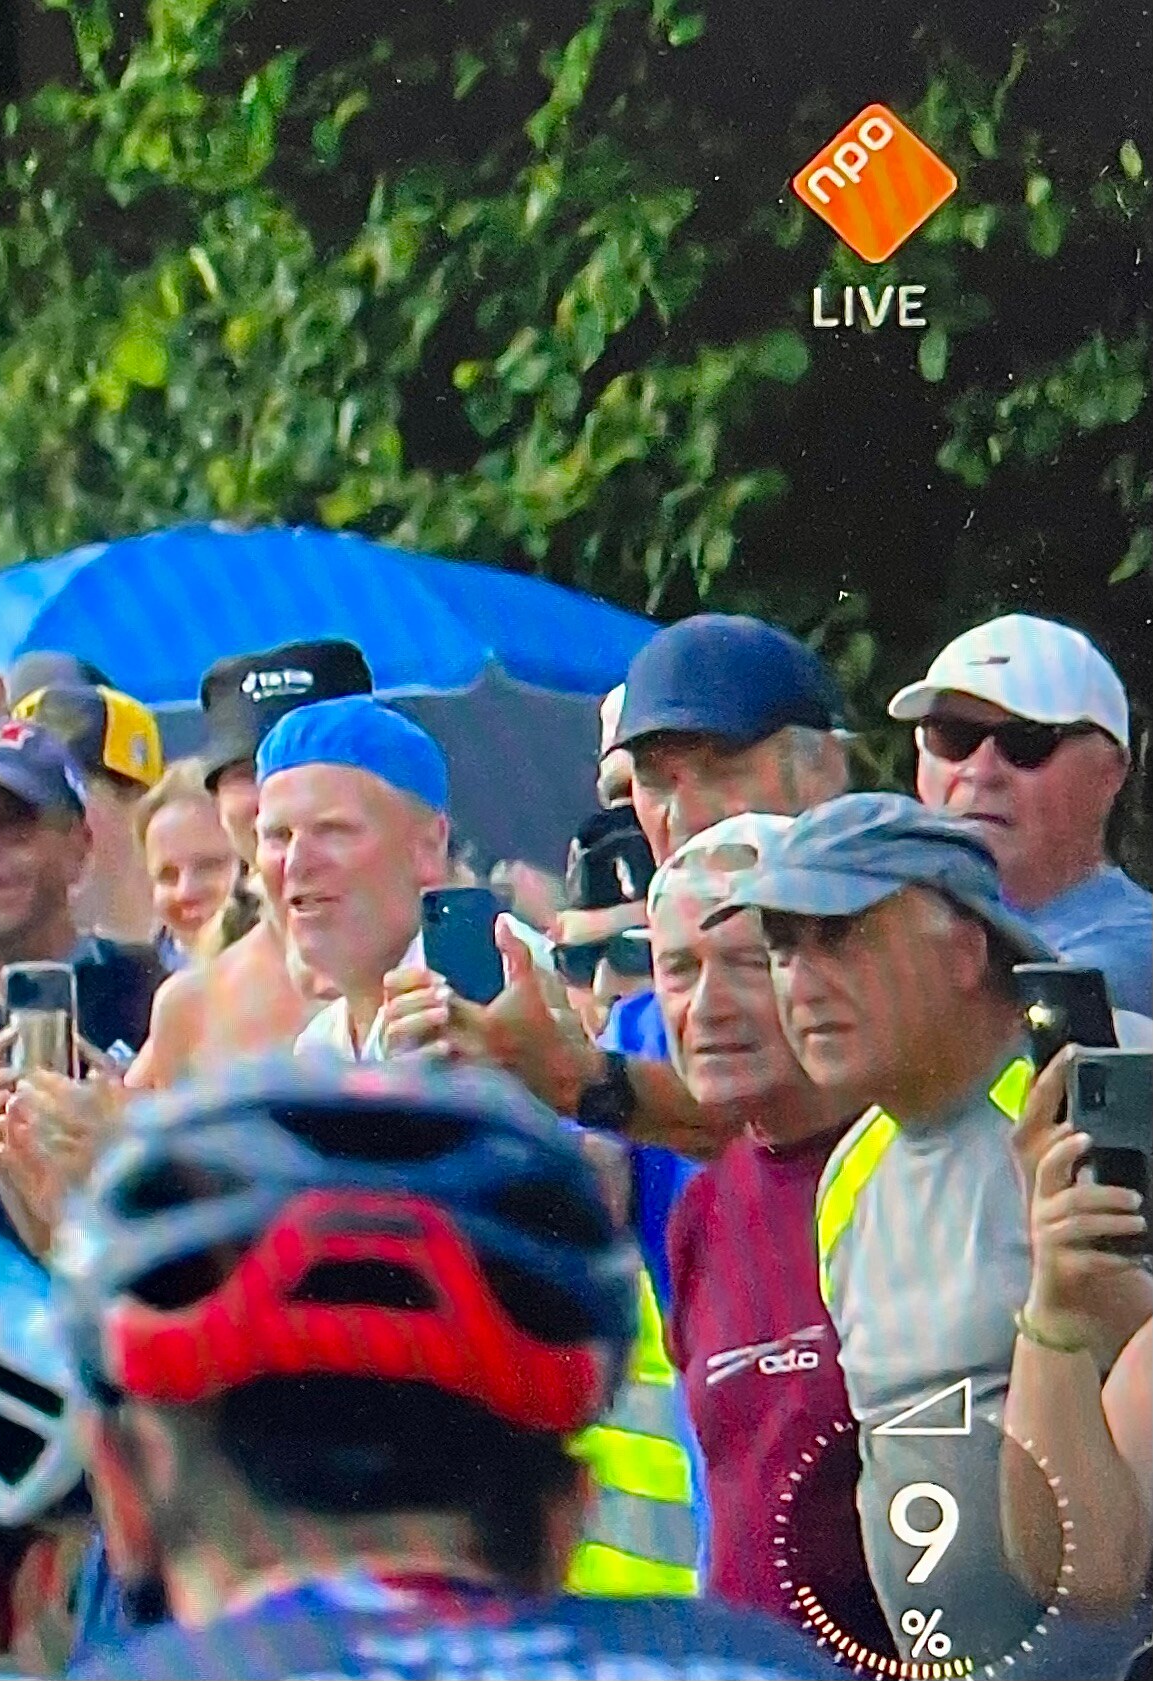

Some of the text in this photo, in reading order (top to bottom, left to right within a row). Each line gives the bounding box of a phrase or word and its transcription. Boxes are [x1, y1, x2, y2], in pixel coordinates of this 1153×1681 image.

[807, 117, 894, 205] npo
[813, 284, 928, 328] LIVE
[889, 1482, 959, 1583] 9
[901, 1608, 952, 1658] %
